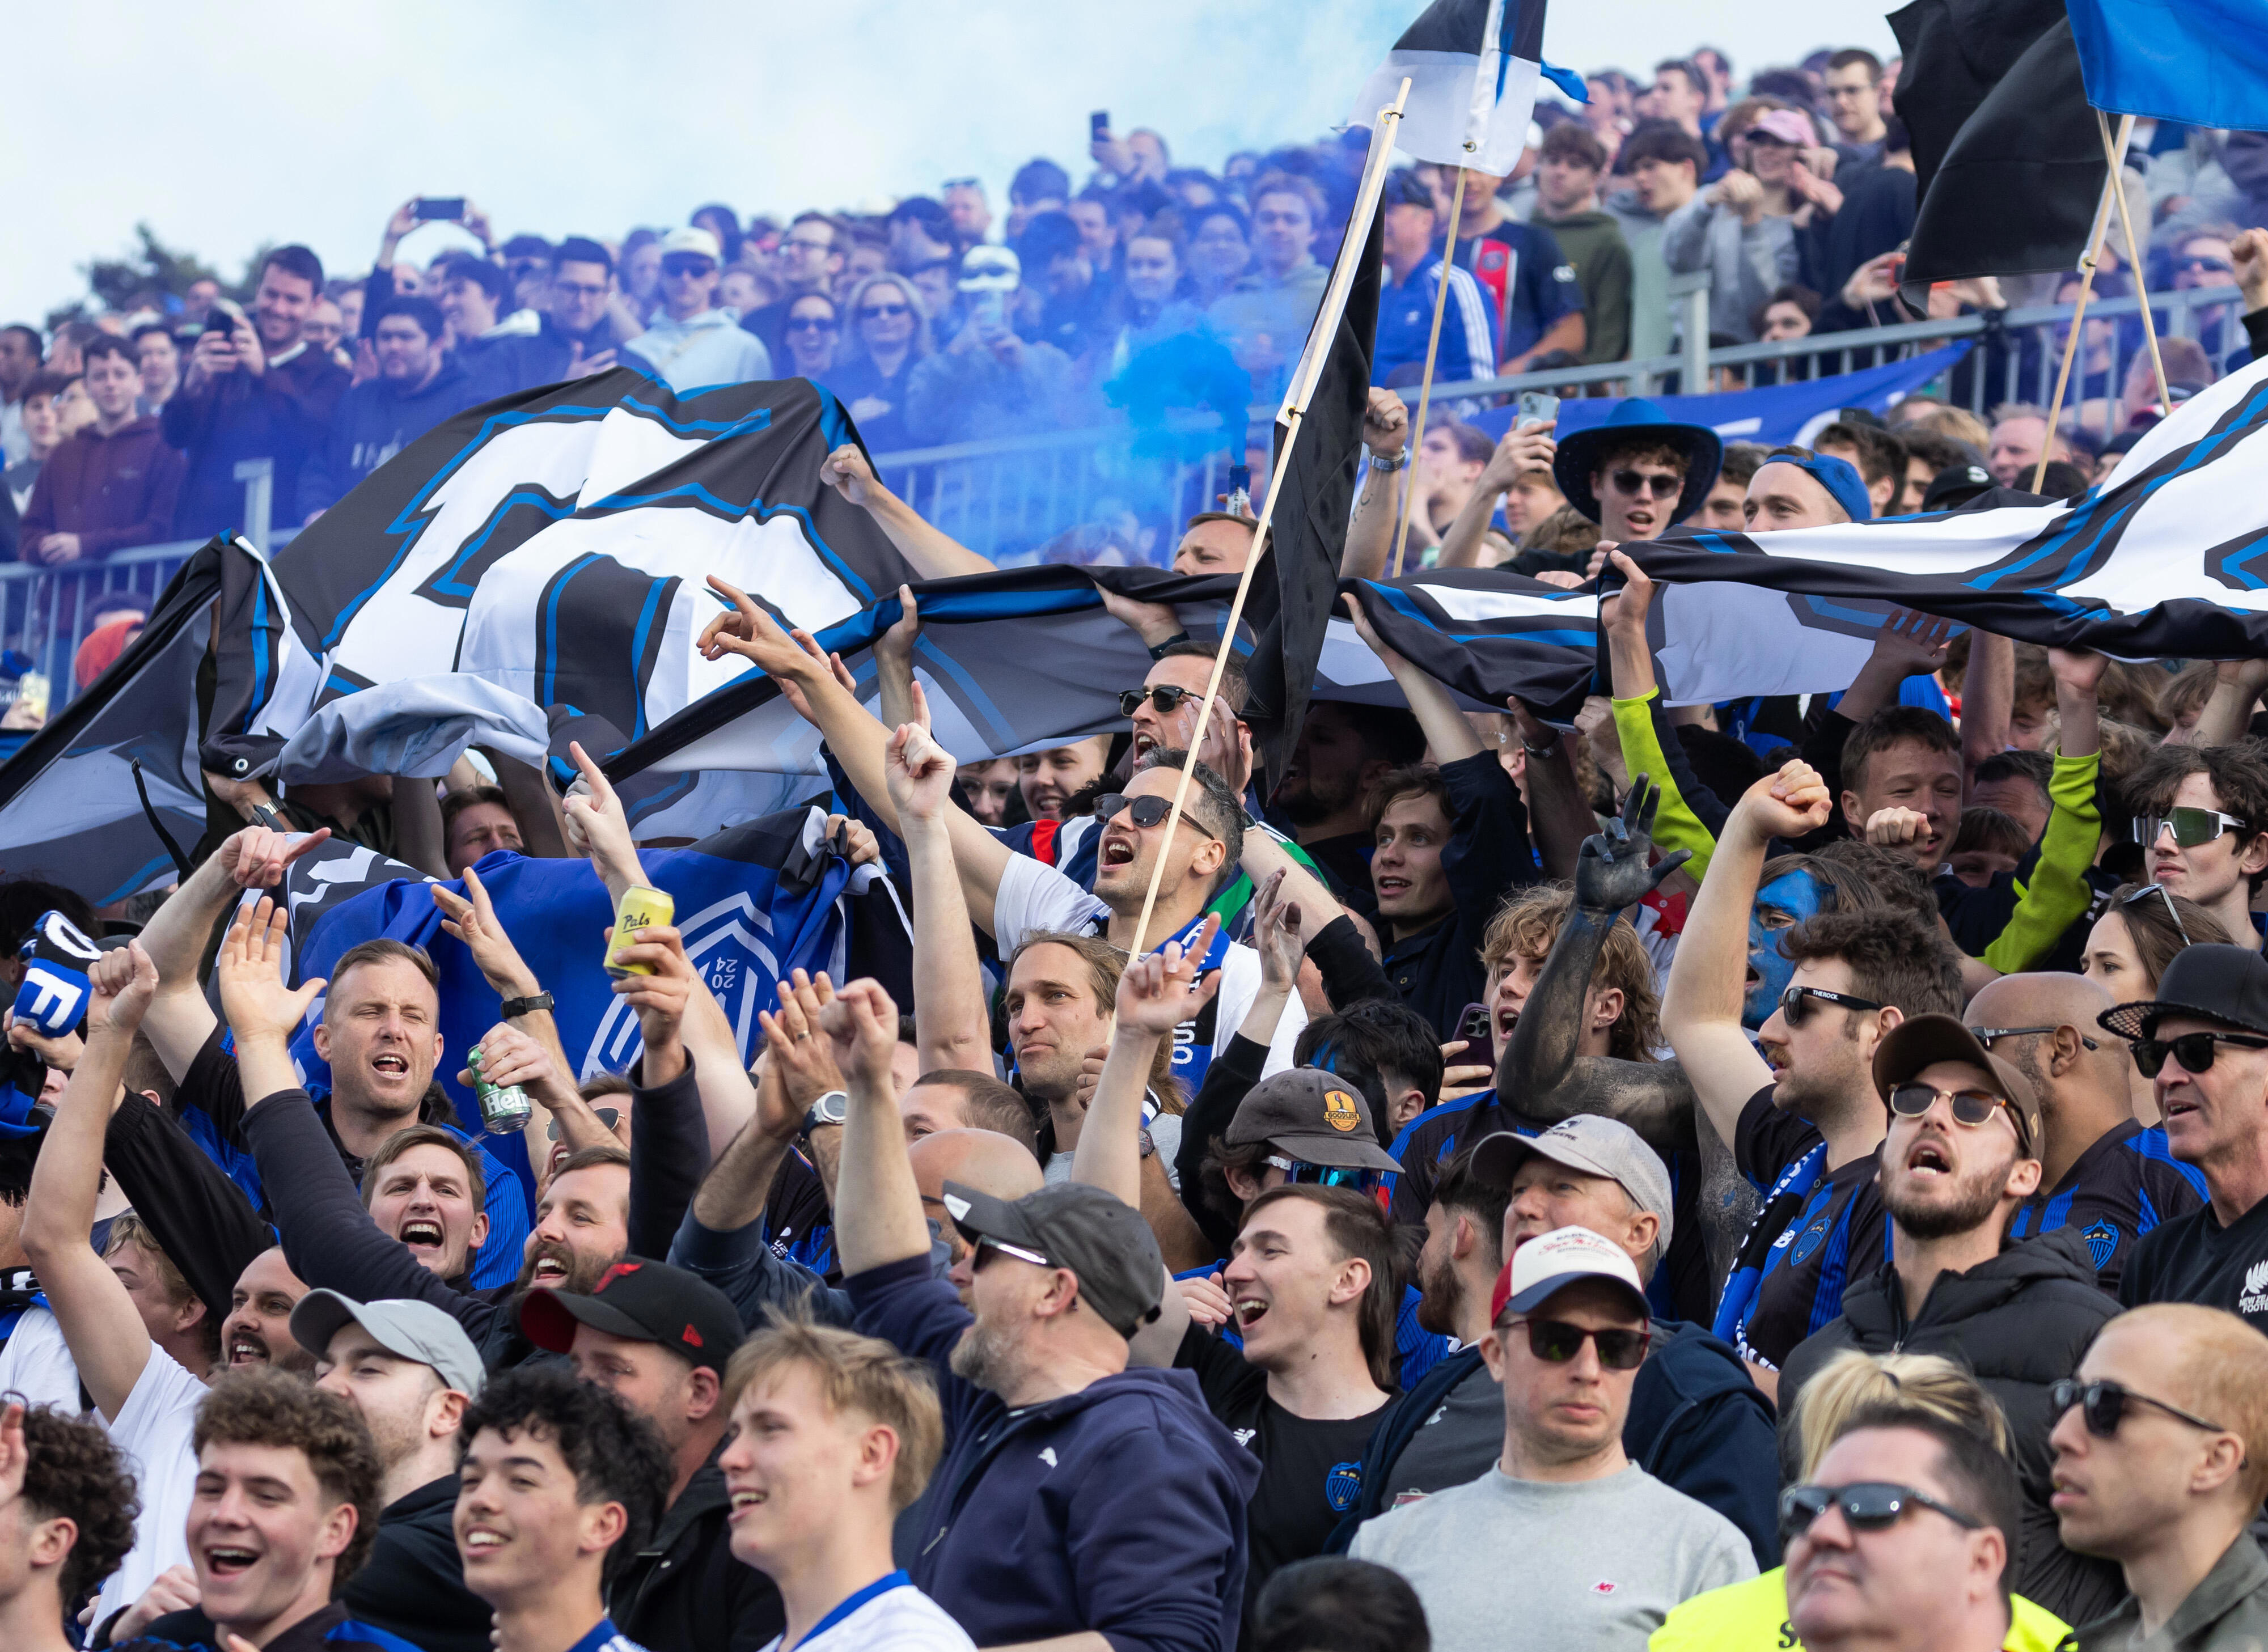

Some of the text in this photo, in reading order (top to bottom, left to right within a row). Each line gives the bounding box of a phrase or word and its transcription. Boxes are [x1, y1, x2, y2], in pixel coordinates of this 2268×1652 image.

[623, 912, 651, 930] Pals
[716, 956, 738, 973] 24
[712, 974, 735, 989] 20
[2239, 1295, 2256, 1307] NEW
